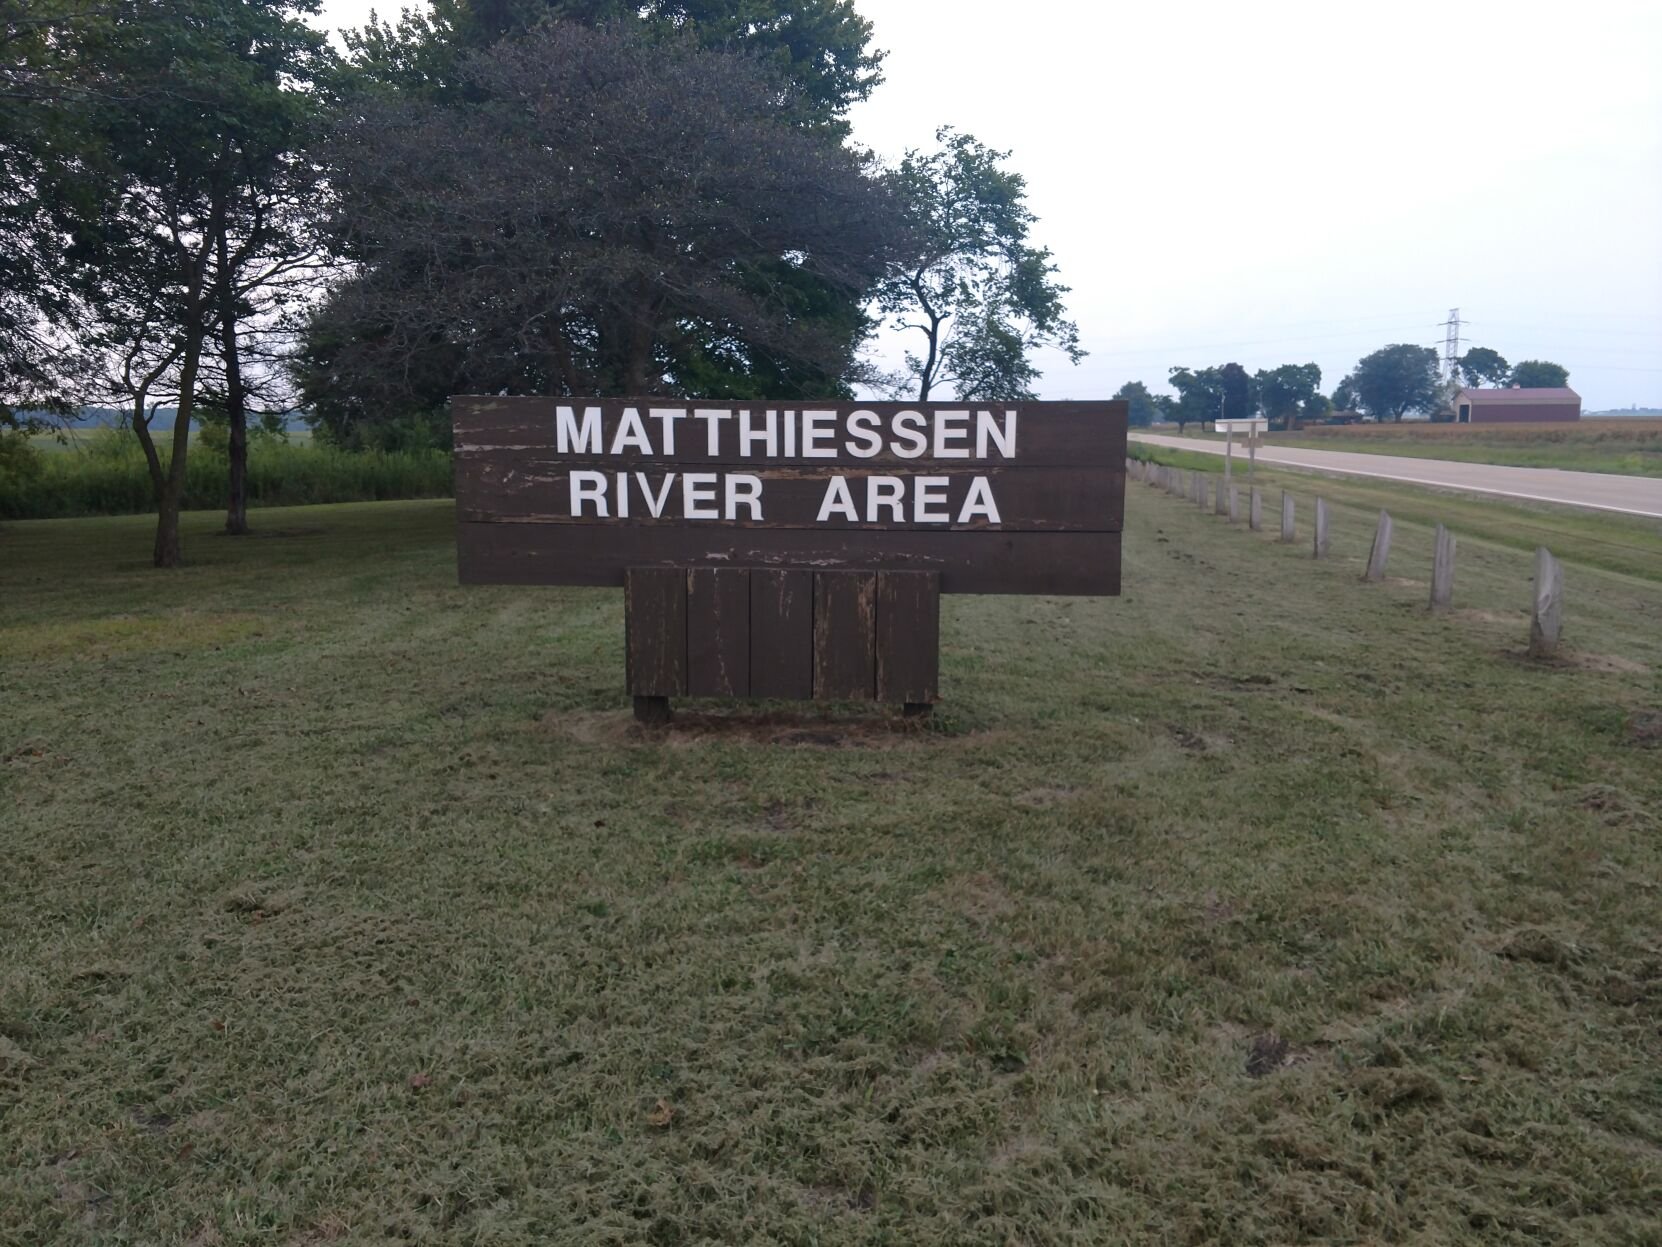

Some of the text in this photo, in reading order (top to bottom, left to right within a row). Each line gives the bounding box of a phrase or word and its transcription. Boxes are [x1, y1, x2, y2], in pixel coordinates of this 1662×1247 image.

[555, 405, 1018, 459] MATTHIESSEN
[568, 470, 1002, 524] RIVER AREA
